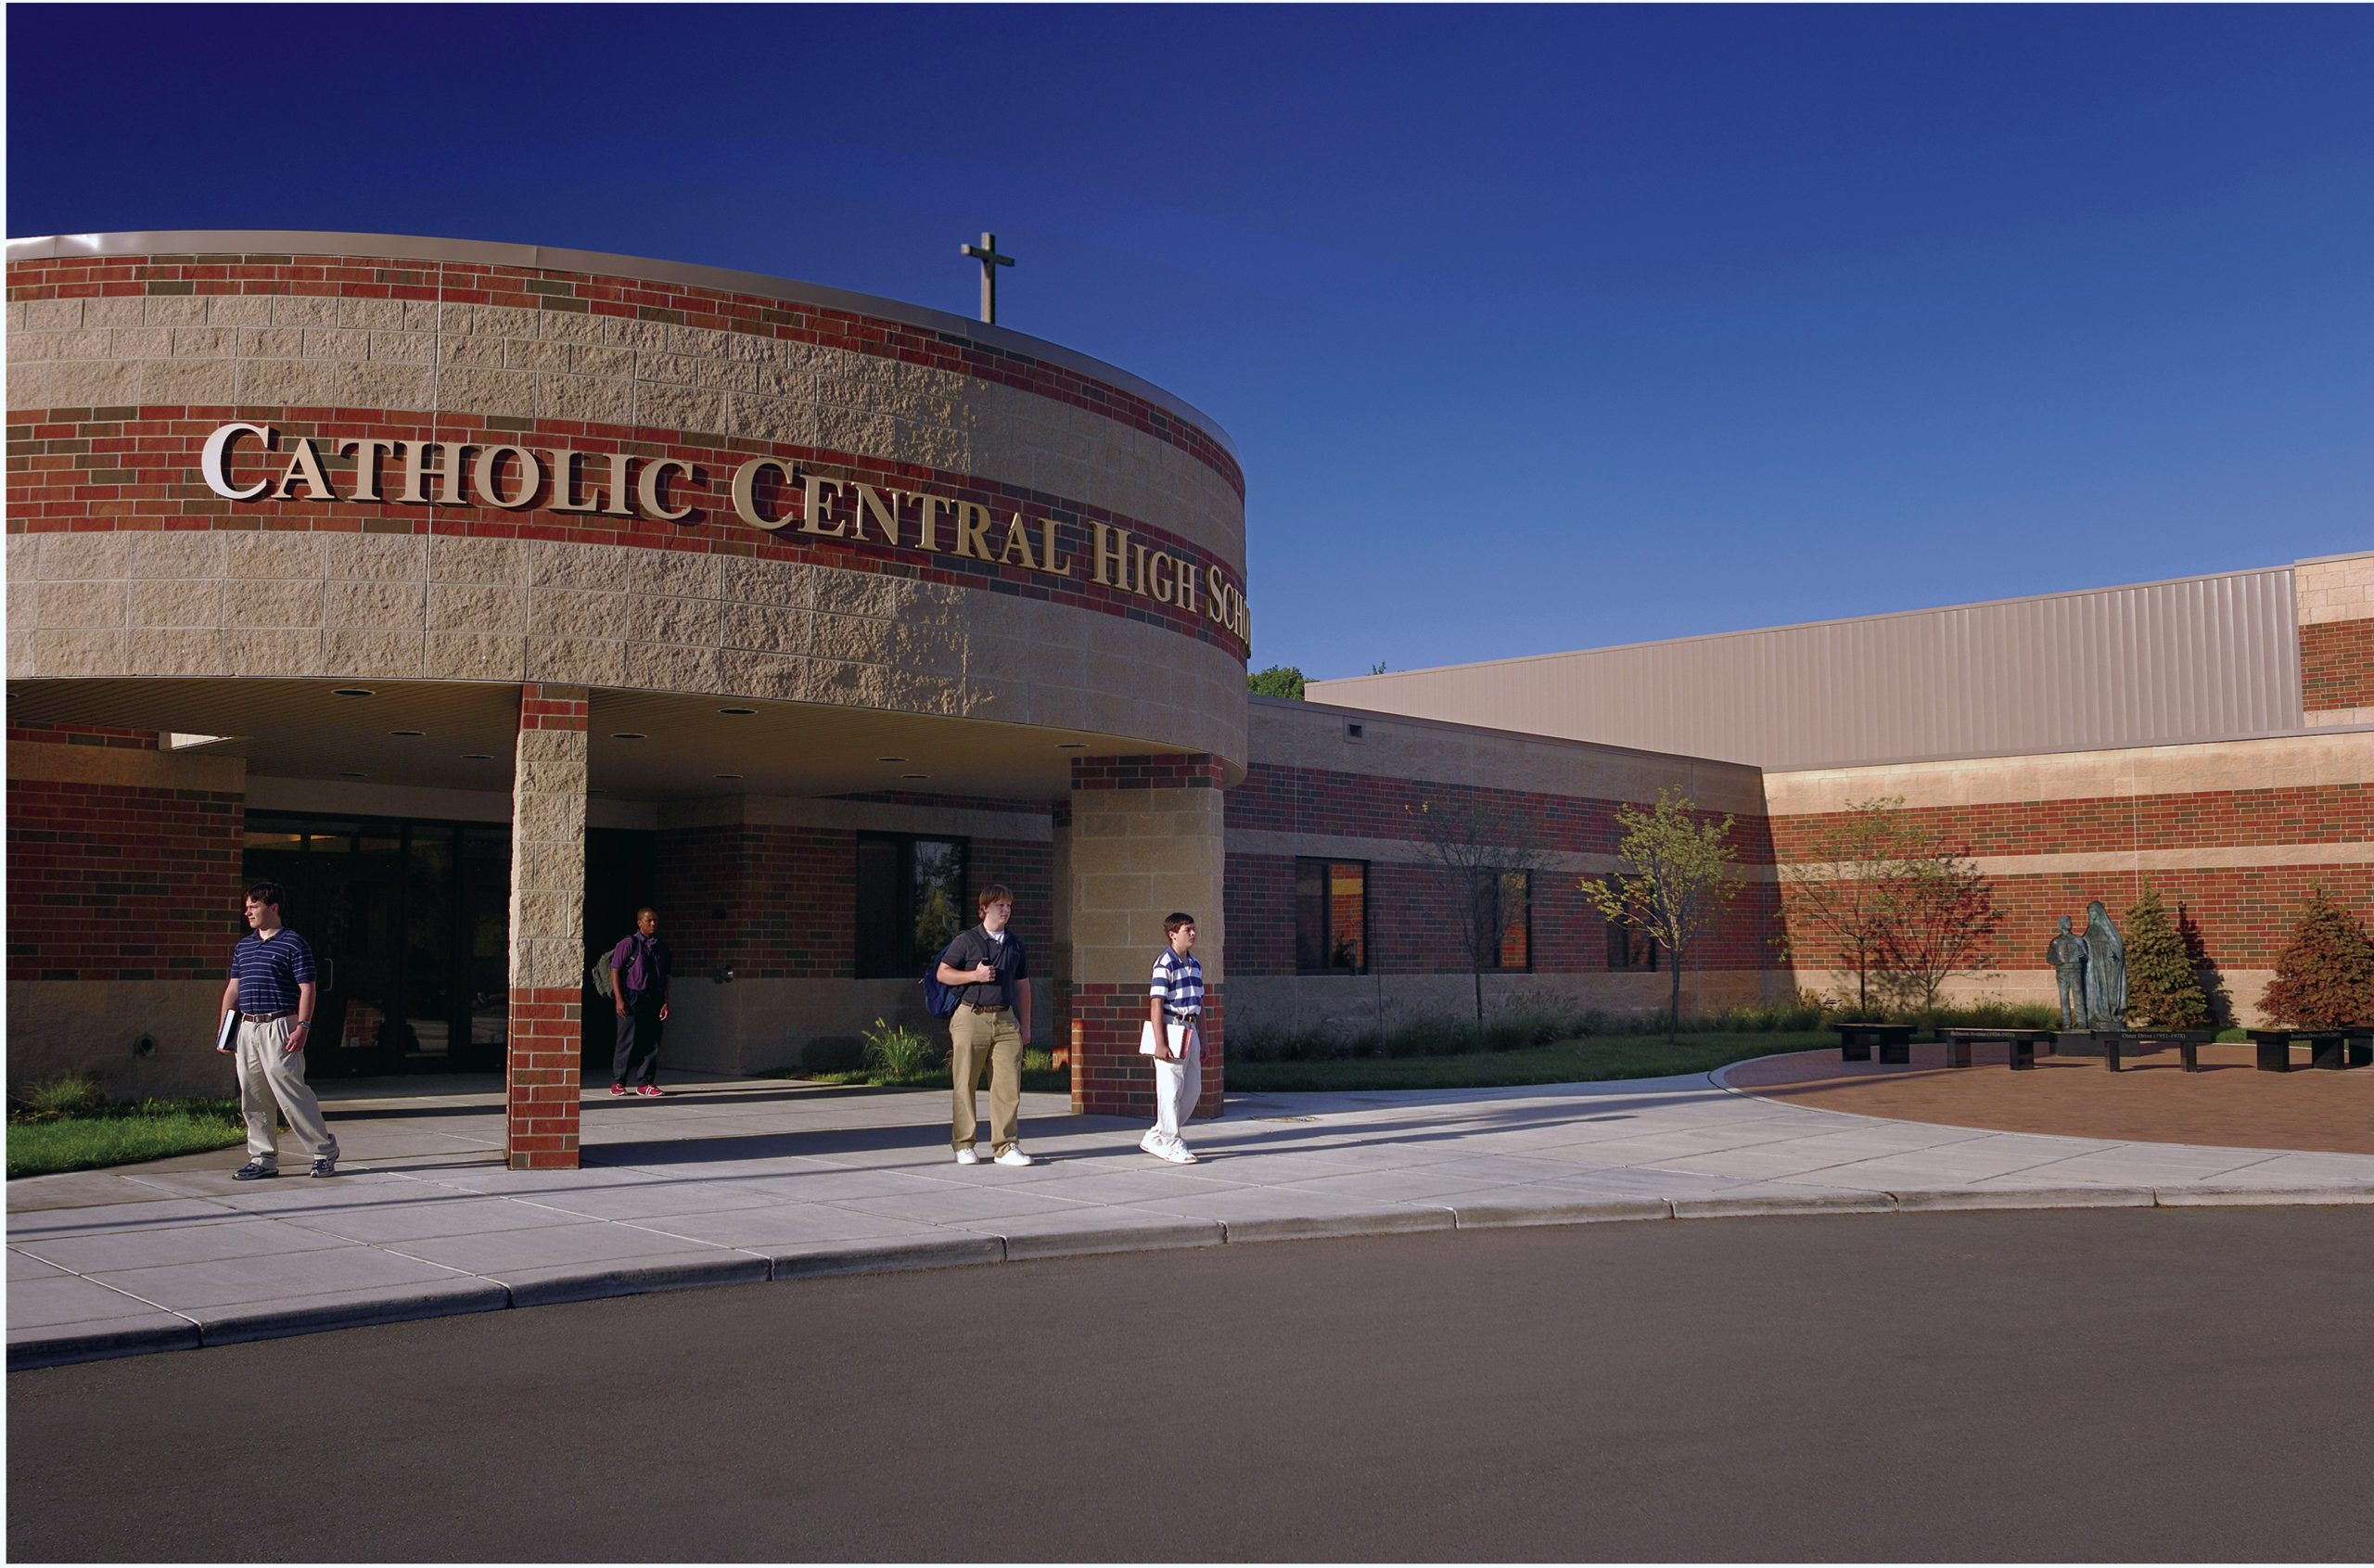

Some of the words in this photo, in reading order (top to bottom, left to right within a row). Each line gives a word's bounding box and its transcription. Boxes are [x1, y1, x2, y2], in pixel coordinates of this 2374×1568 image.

[201, 423, 694, 520] CATHOLIC
[732, 457, 1070, 576] CENTRAL
[1089, 520, 1198, 613] HIGH
[1207, 564, 1251, 655] SCHO
